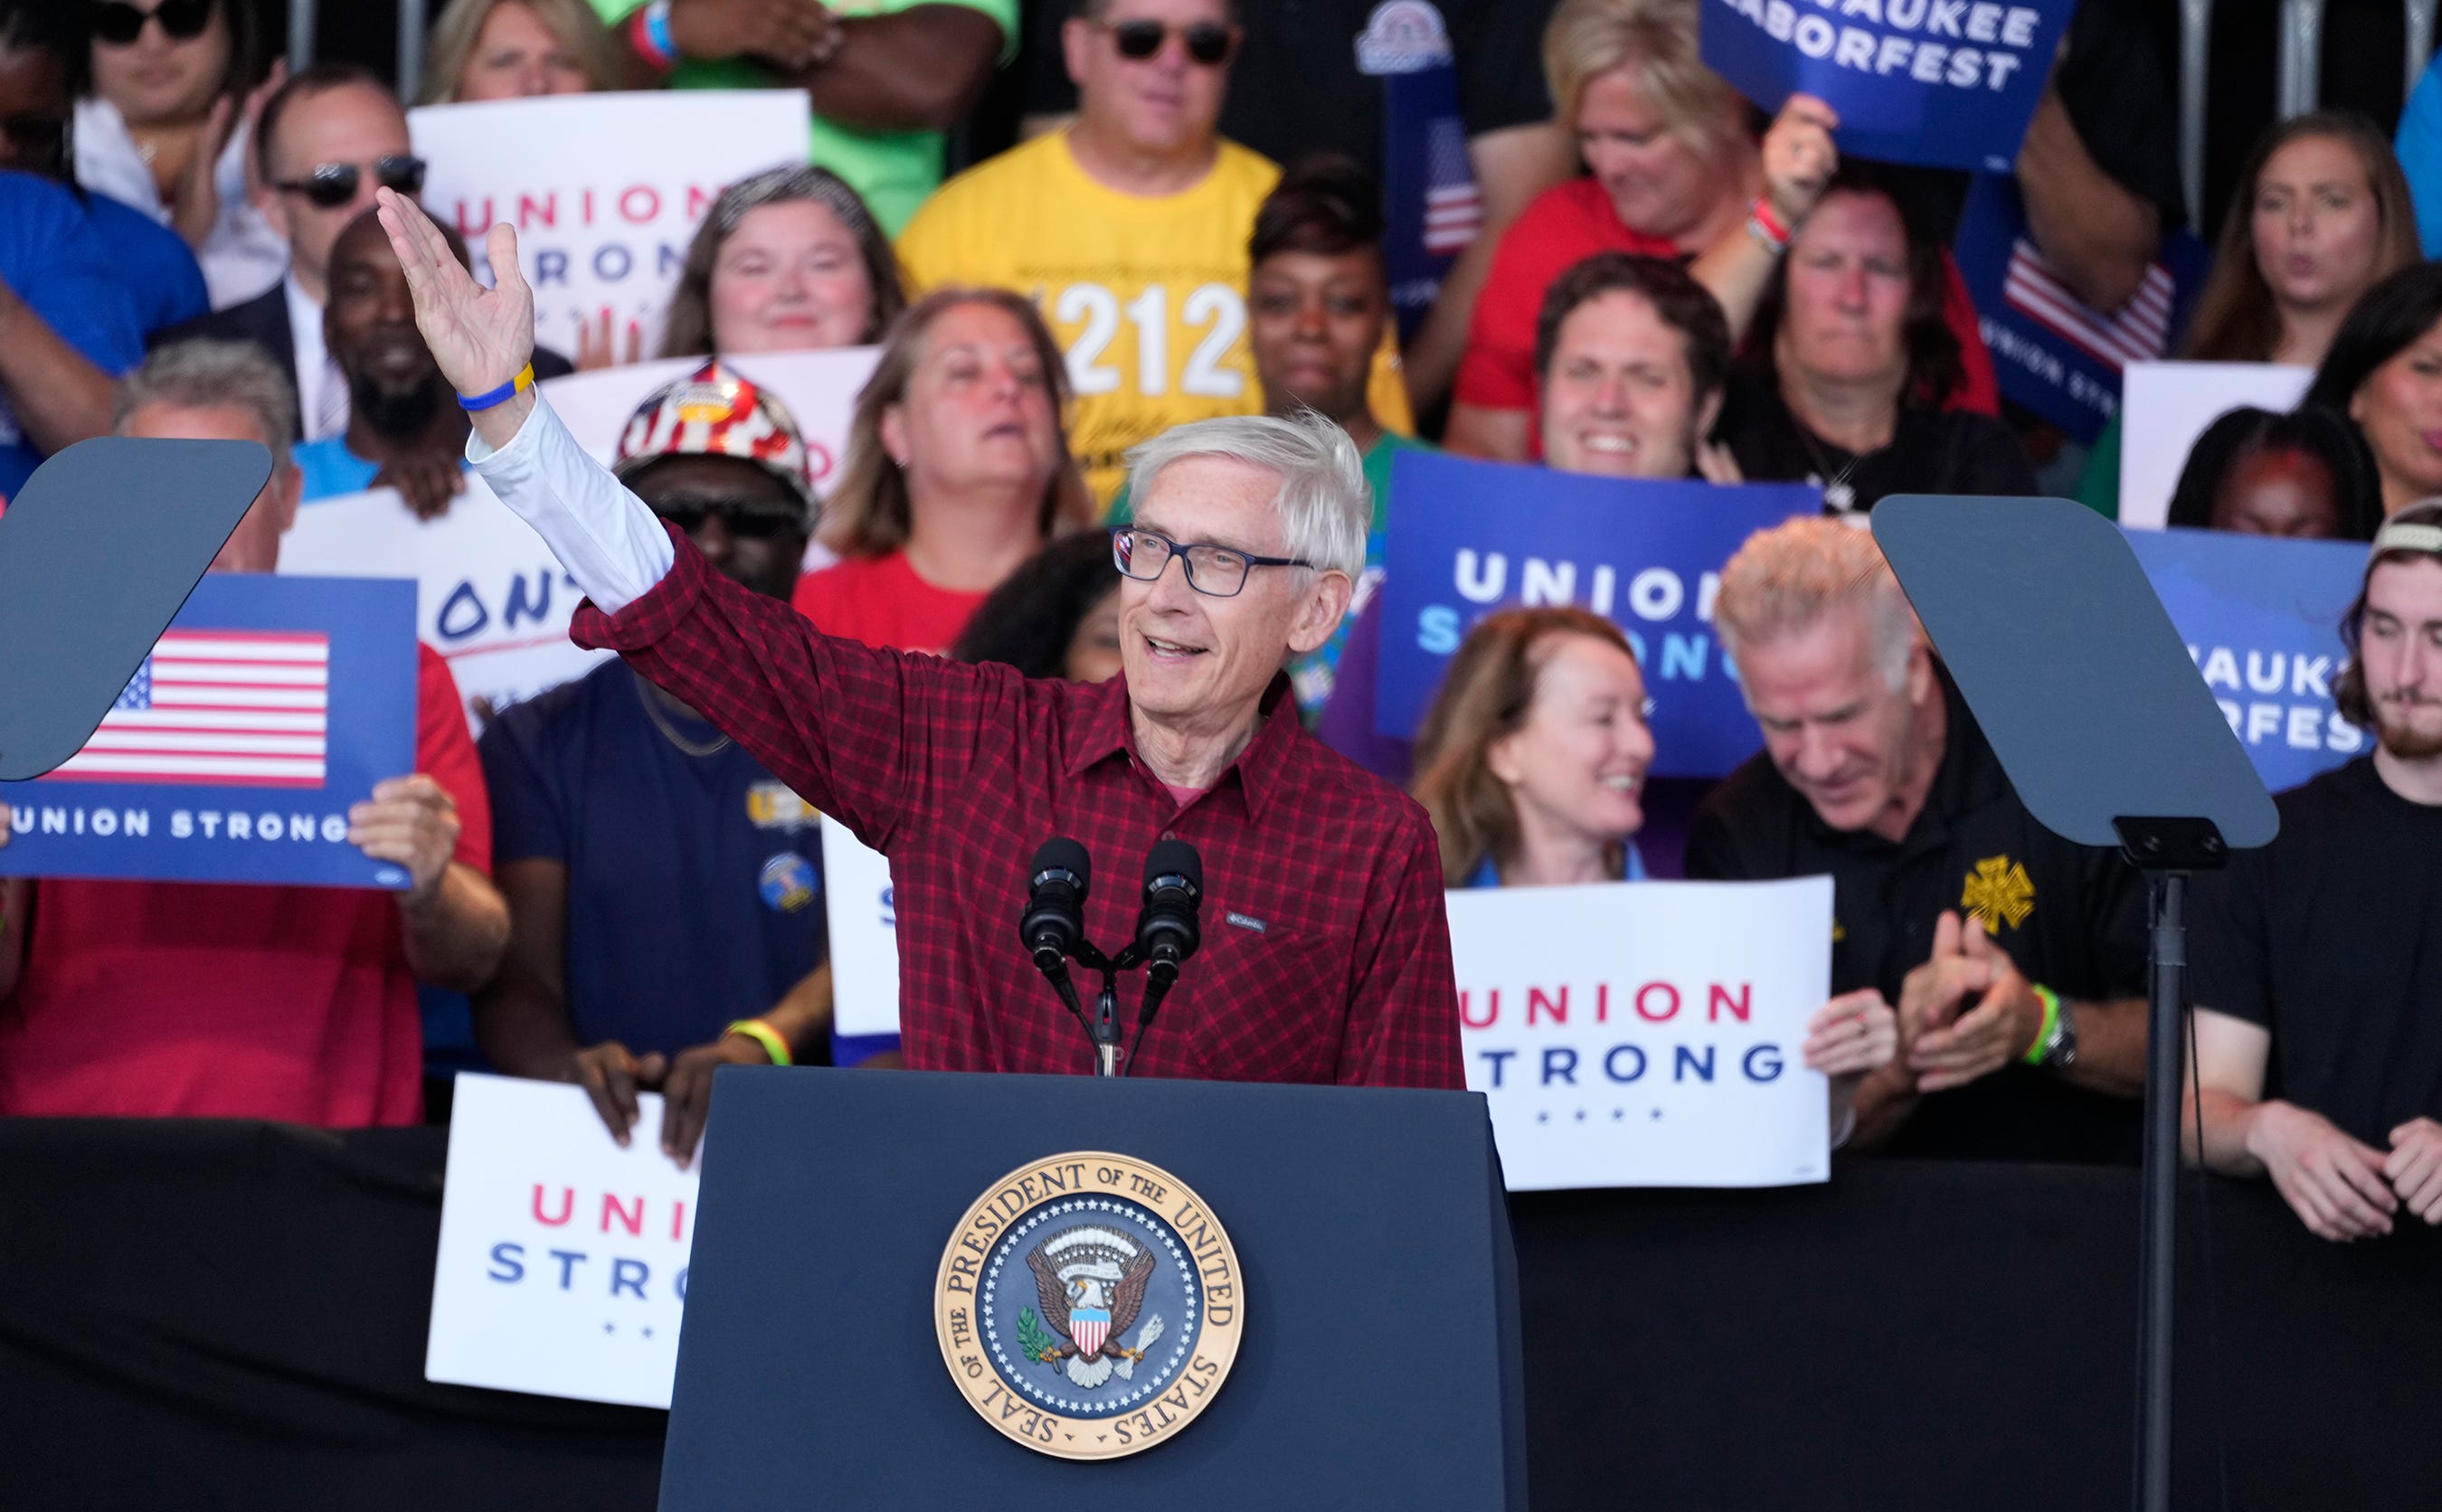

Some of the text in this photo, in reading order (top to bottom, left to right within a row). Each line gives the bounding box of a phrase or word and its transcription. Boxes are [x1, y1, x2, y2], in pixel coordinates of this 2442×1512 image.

[1814, 0, 2040, 48] AUKEE
[1031, 281, 1247, 398] 212
[11, 807, 349, 843] UNION STRONG
[1460, 981, 1752, 1029] UNION
[1479, 1044, 1784, 1087] TRONG
[532, 1183, 684, 1243] UNI
[487, 1242, 689, 1305] STR
[947, 1163, 1234, 1445] SEAL OF THE PRESIDENT OF THE UNITED STATES
